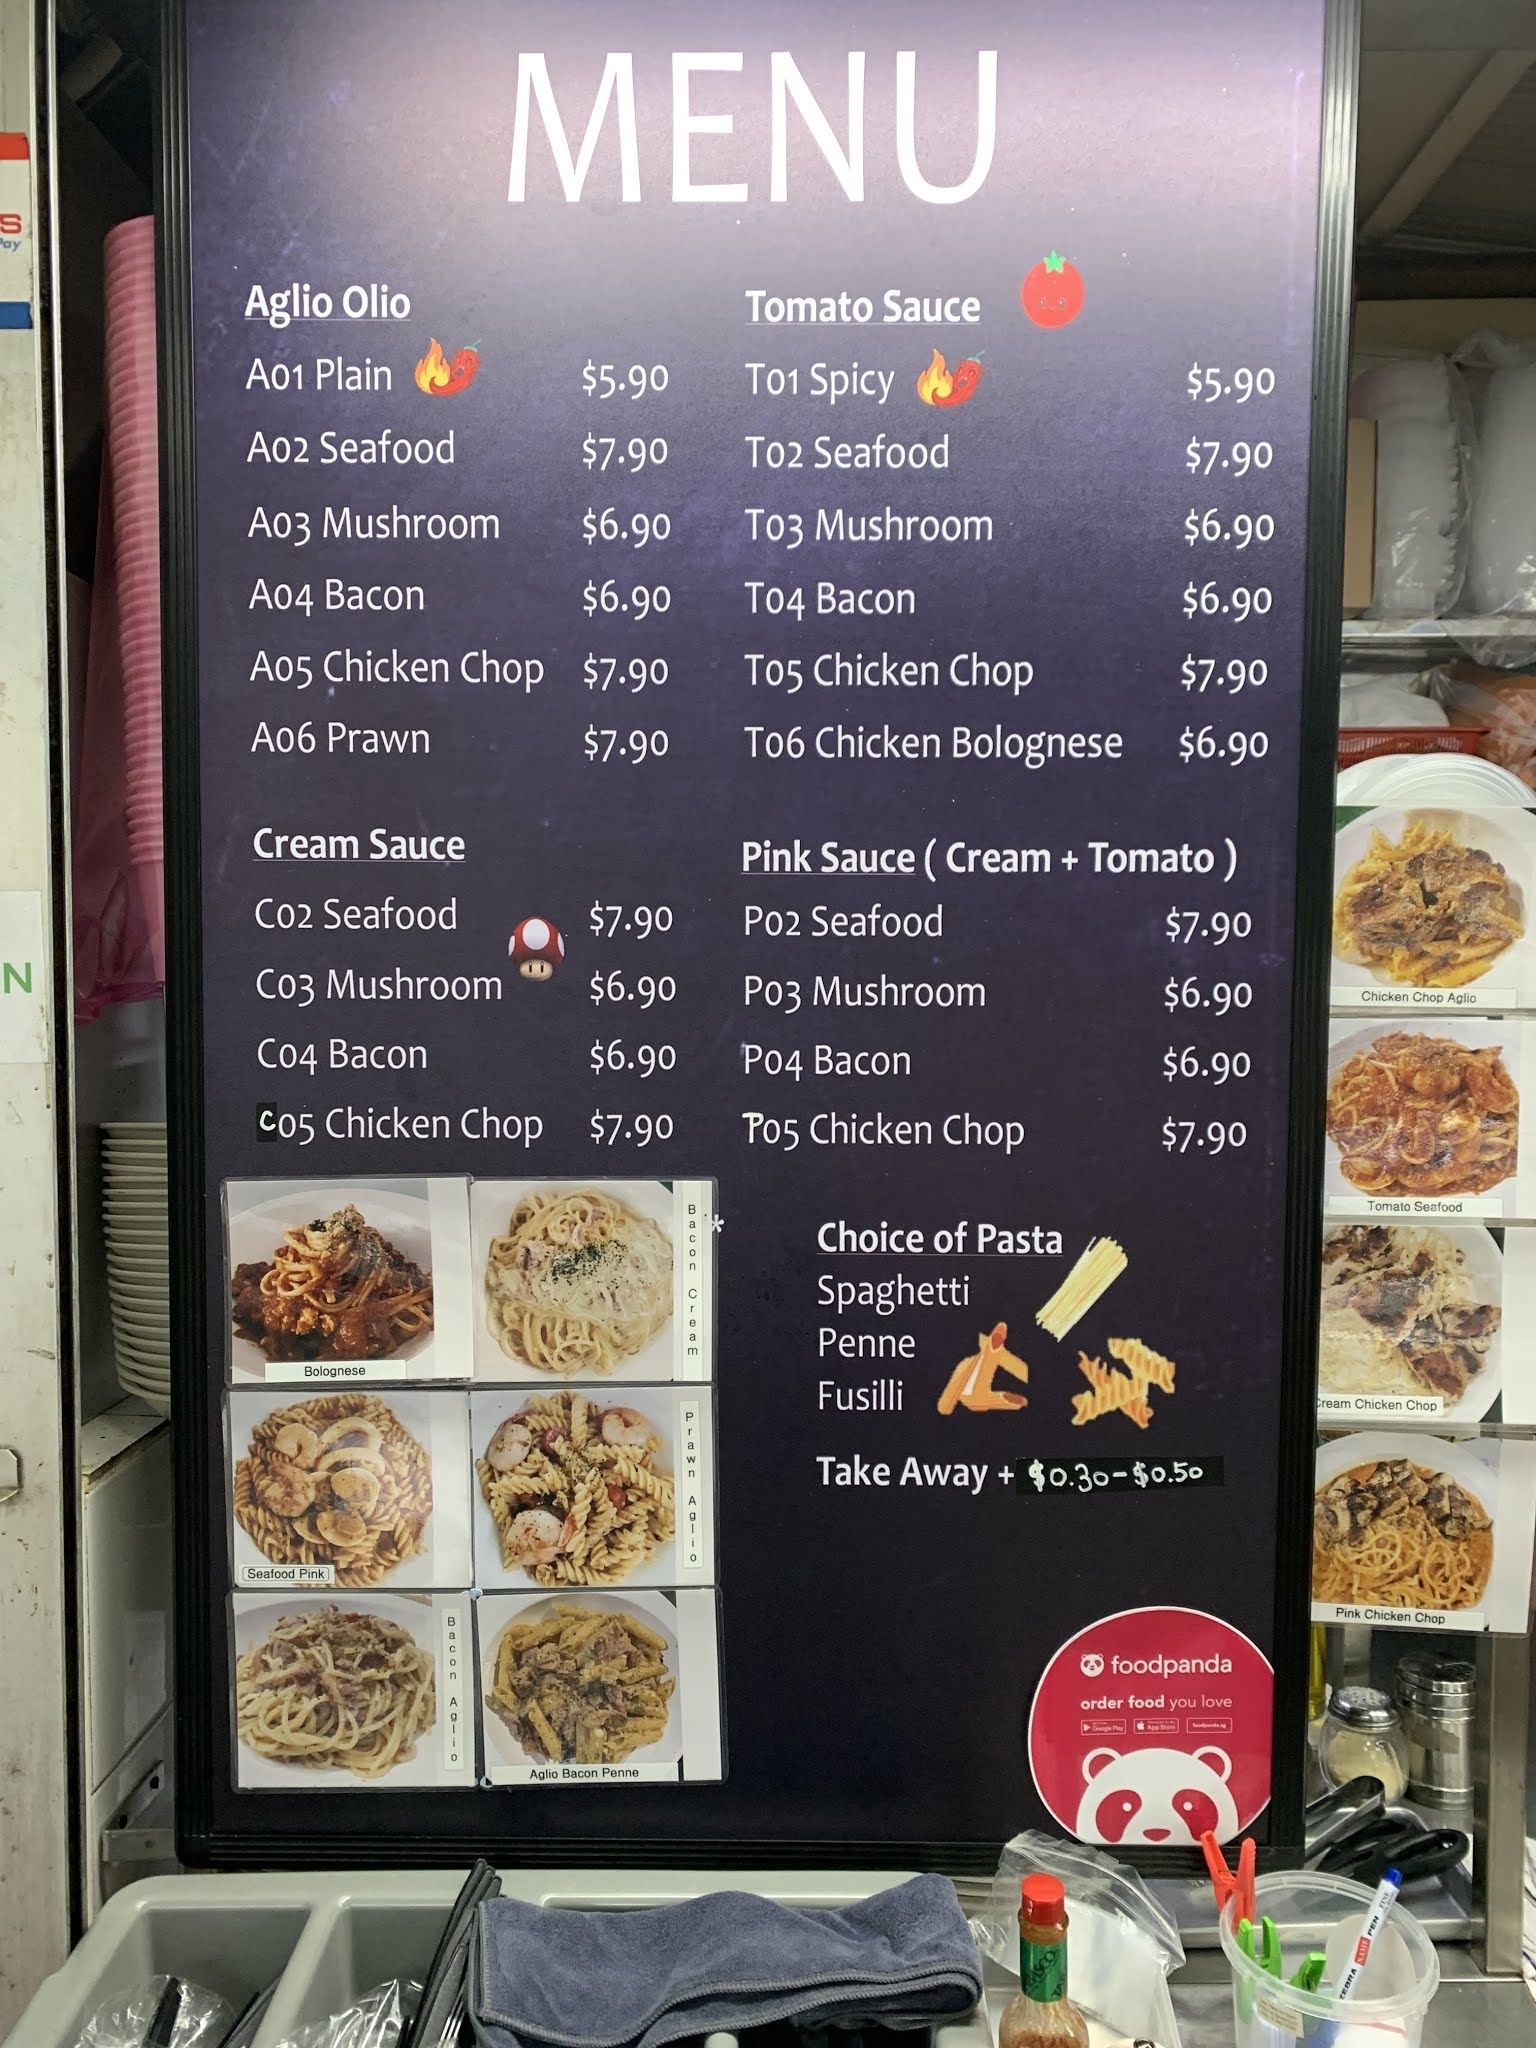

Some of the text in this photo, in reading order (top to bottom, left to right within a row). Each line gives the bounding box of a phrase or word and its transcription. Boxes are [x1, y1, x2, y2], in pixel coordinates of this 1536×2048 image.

[507, 50, 998, 205] MENU
[244, 282, 411, 329] Aglio Olio
[744, 289, 981, 323] Tomato Sauce
[245, 356, 392, 391] A01 Plain
[582, 358, 669, 400] $5.90
[744, 361, 895, 405] T01 Spicy
[1187, 361, 1275, 404] $5.90
[246, 428, 455, 464] A02 Seafood
[582, 431, 668, 473] $7.90
[744, 433, 949, 469] T02 Seafood
[1186, 435, 1273, 477] $7.90
[247, 504, 500, 547] A03 Mushroom
[582, 506, 671, 549] $6.90
[744, 506, 993, 550] T03 Mushroom
[1184, 507, 1275, 550] $6.90
[248, 578, 424, 617] A04 Bacon
[583, 579, 671, 621] $6.90
[744, 581, 915, 621] T04 Bacon
[1183, 581, 1272, 623] $6.90
[249, 648, 544, 694] A05 Chicken Chop
[583, 652, 669, 693] $7.90
[744, 651, 1034, 696] T05 Chicken Chop
[1181, 653, 1268, 694] $7.90
[250, 721, 430, 754] A06 Prawn
[584, 723, 669, 765] $7.90
[744, 724, 1123, 769] T06 Chicken Bolognese
[1179, 725, 1269, 767] $6.90
[253, 827, 466, 860] Cream Sauce
[742, 839, 813, 872] Pink
[820, 841, 916, 873] Sauce
[946, 841, 1051, 873] Cream
[1087, 841, 1215, 873] Tomato
[255, 896, 457, 930] C02 Seafood
[590, 900, 673, 940] $7.90
[745, 903, 943, 937] P02 Seafood
[1166, 905, 1252, 946] $7.90
[256, 967, 502, 1008] C03 Mushroom
[590, 969, 676, 1010] $6.90
[745, 973, 985, 1014] P03 Mushroom
[1164, 976, 1253, 1016] $6.90
[1361, 990, 1477, 1005] Chicken Chop Aglio
[257, 1037, 427, 1076] C04 Bacon
[590, 1038, 676, 1078] $6.90
[744, 1043, 911, 1082] P04 Bacon
[1163, 1045, 1251, 1086] $6.90
[325, 1106, 450, 1139] Chicken
[460, 1106, 543, 1148] Chop
[590, 1108, 674, 1147] $7.90
[741, 1111, 1025, 1155] P05 Chicken Chop
[1162, 1115, 1247, 1155] $7.90
[1367, 1200, 1463, 1213] Tomato Seafood
[817, 1220, 1063, 1254] Choice of Pasta
[687, 1204, 698, 1356] Bacon Cream
[818, 1275, 970, 1315] Spaghetti
[819, 1327, 916, 1358] Penne
[304, 1366, 366, 1378] Bolognese
[819, 1378, 903, 1411] Fusilli
[1355, 1398, 1402, 1410] Chicken
[1406, 1399, 1438, 1413] Chop
[685, 1412, 696, 1478] Prawn
[816, 1454, 891, 1486] Take
[899, 1456, 989, 1496] Away
[247, 1568, 325, 1579] Seafood Pink
[1336, 1607, 1446, 1625] Pink Chicken Chop
[447, 1616, 457, 1680] Bacon
[1111, 1653, 1233, 1679] foodpanda
[1080, 1694, 1233, 1711] order food you love
[1147, 1724, 1159, 1732] App
[529, 1767, 639, 1780] Aglio Bacon Penne
[1338, 1968, 1357, 2000] ZEBRA
[1367, 1915, 1380, 1936] PEN
